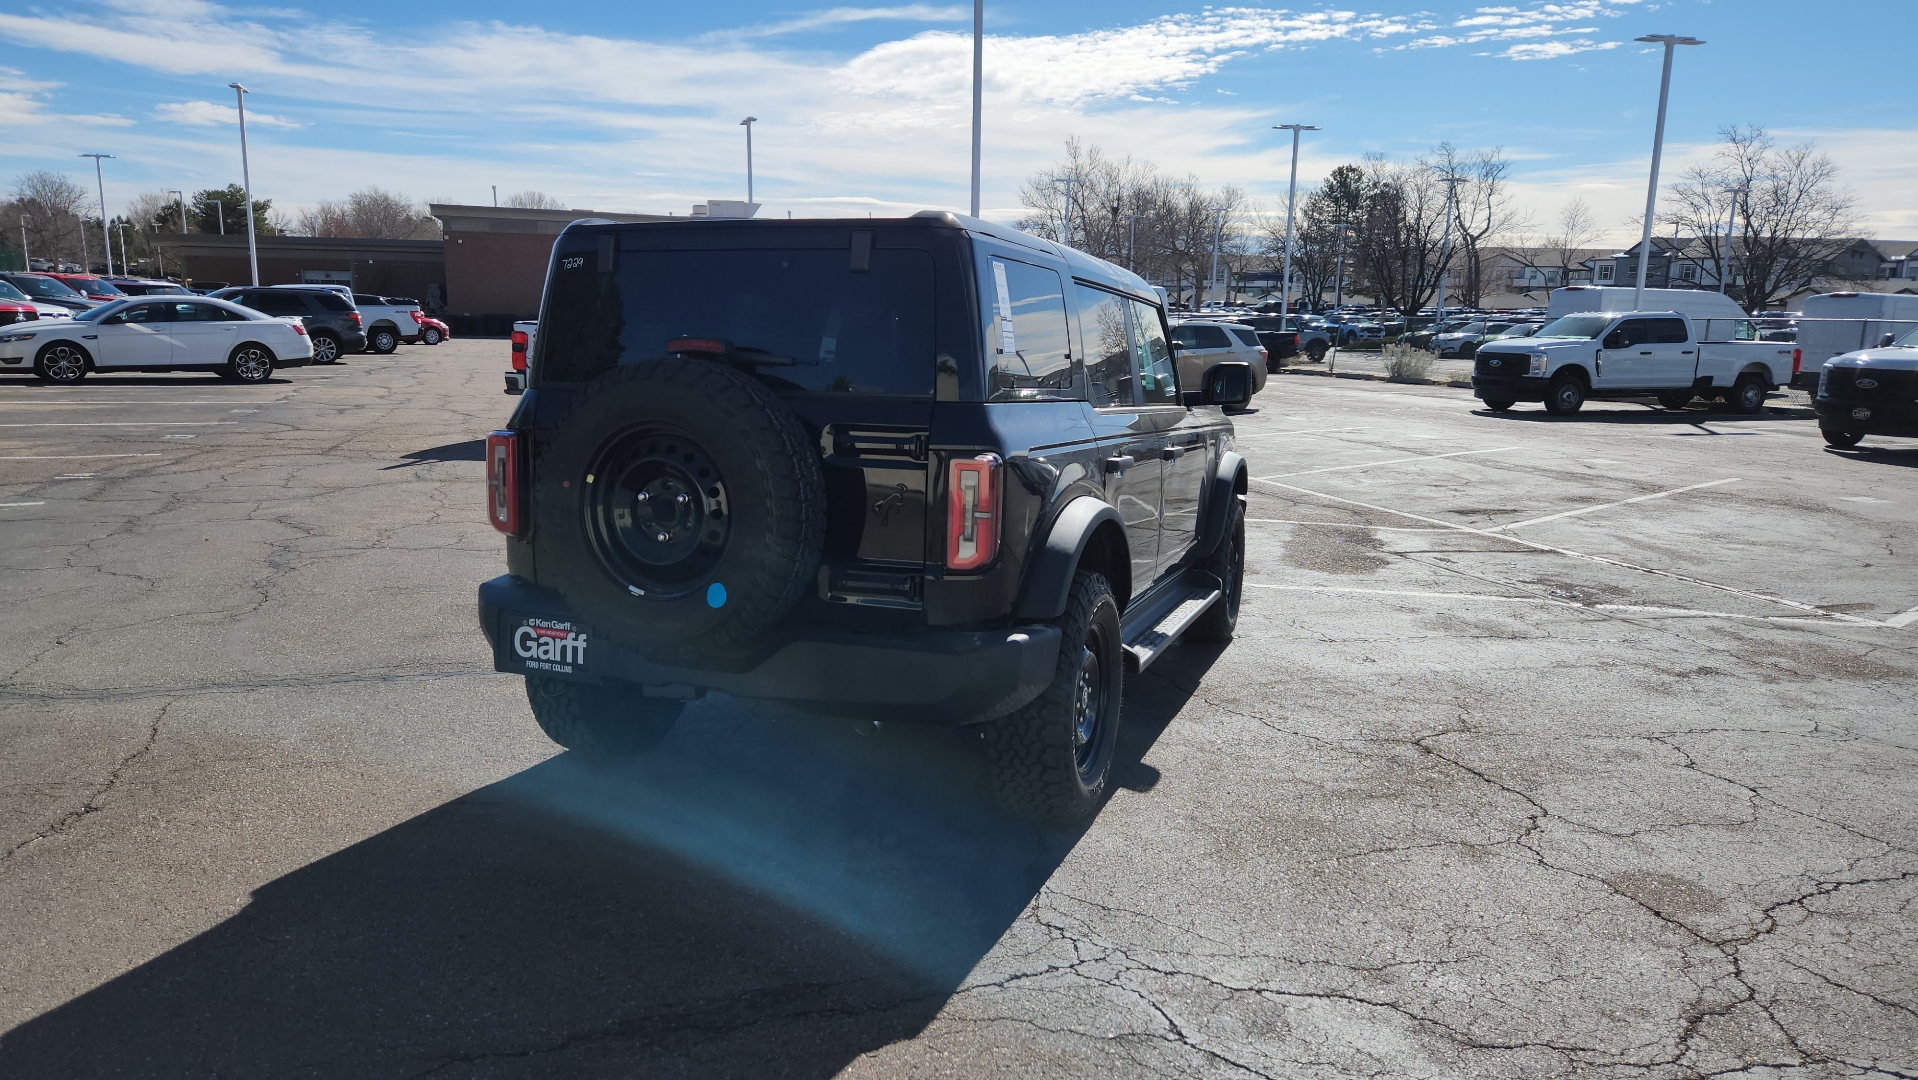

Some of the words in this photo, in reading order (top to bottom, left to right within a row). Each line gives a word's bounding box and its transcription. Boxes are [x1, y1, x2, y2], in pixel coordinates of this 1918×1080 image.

[562, 257, 584, 270] 7229
[536, 618, 550, 628] Ken
[551, 620, 571, 630] Garff
[514, 626, 587, 664] Garff
[526, 660, 539, 669] FORD
[539, 662, 552, 670] FORT
[552, 664, 573, 673] COLLINS
